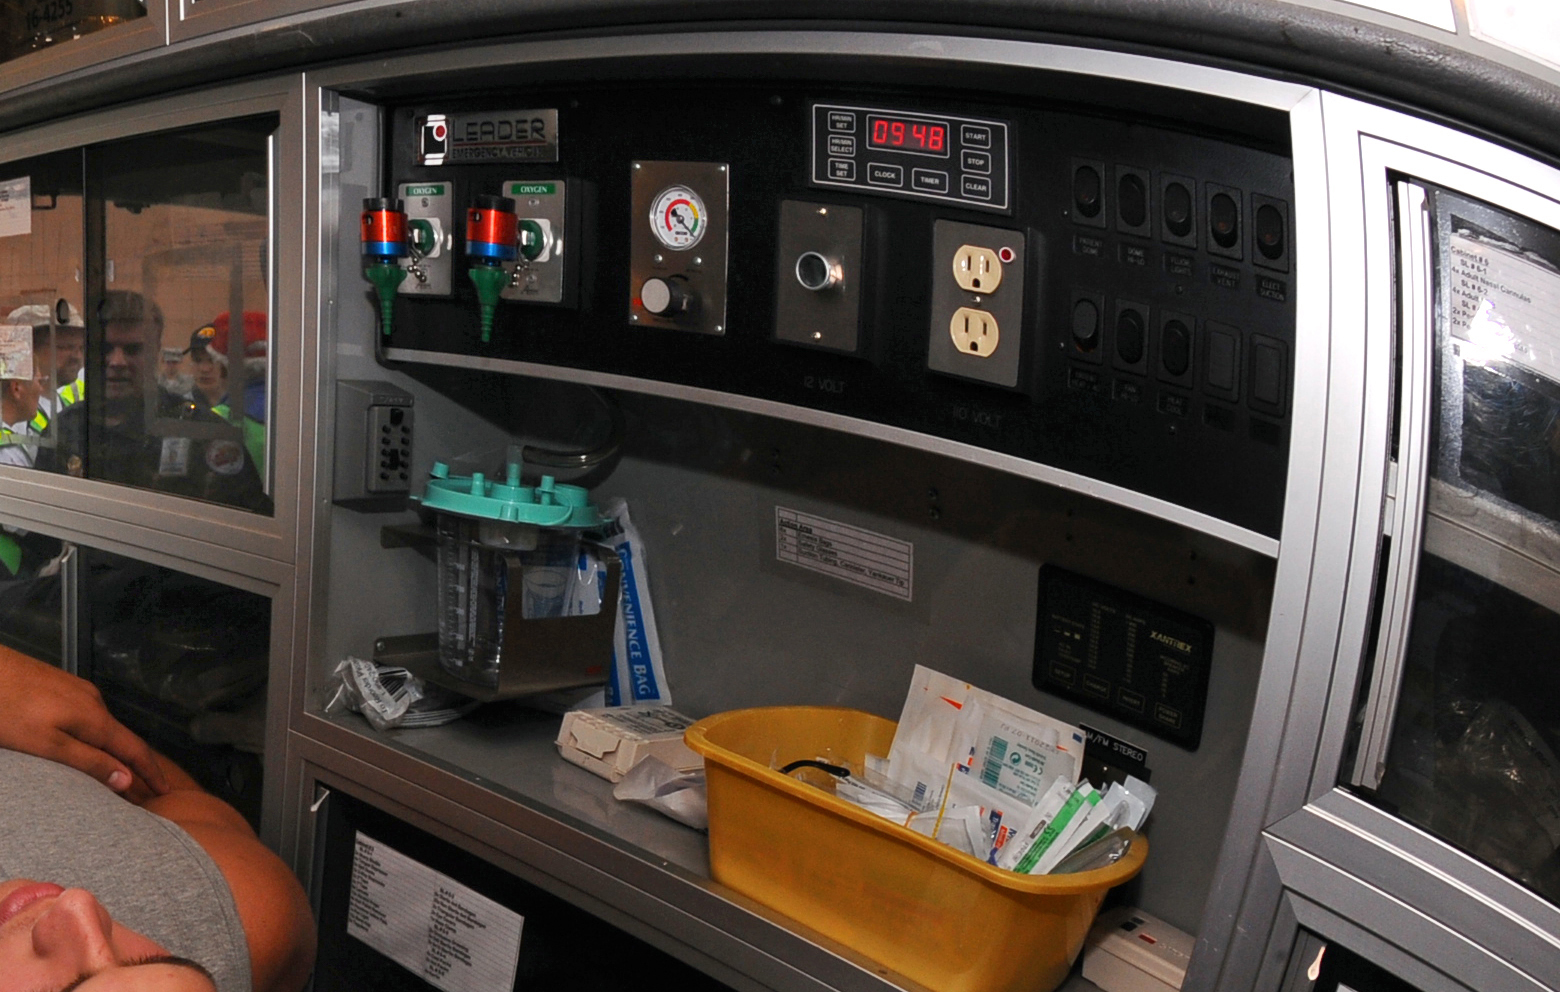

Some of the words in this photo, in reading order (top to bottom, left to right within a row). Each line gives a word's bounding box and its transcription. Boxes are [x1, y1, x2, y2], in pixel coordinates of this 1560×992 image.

[453, 118, 546, 142] LEADER
[965, 132, 986, 141] START
[830, 146, 853, 154] SELECT
[967, 158, 984, 166] STOP
[874, 171, 896, 180] CLOCK
[920, 176, 940, 185] TIMER
[520, 186, 548, 194] OXYGEN
[965, 183, 987, 192] CLEAR
[1451, 246, 1478, 262] Cabinet
[1461, 270, 1480, 282] Adult
[1462, 290, 1480, 302] Adult
[818, 378, 844, 394] VOLT
[972, 410, 1002, 428] VOLT
[1150, 630, 1192, 653] XANTREX
[633, 664, 650, 695] BAG
[1086, 732, 1109, 748] M/FM
[1113, 742, 1144, 762] STEREO
